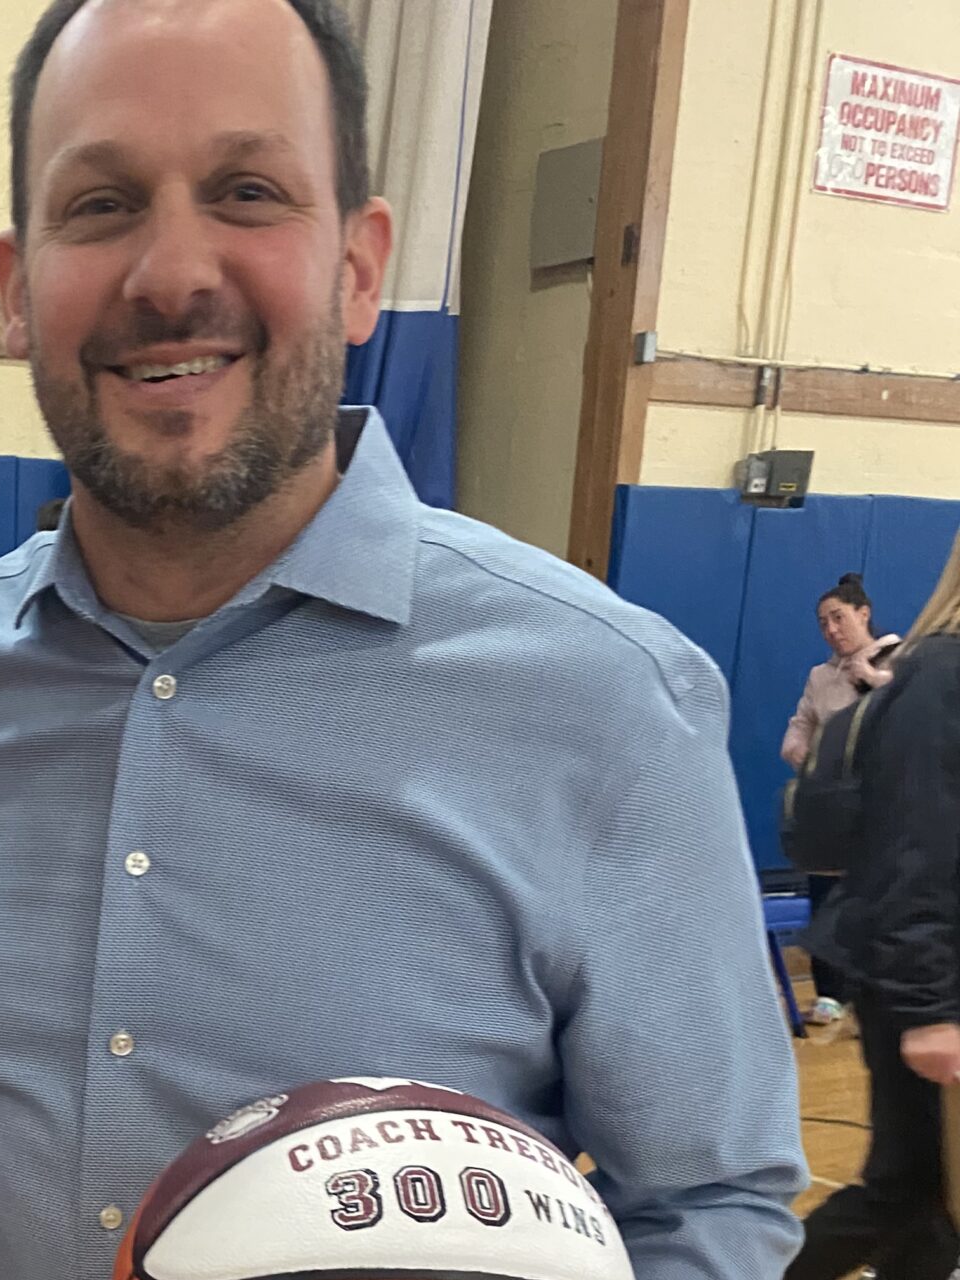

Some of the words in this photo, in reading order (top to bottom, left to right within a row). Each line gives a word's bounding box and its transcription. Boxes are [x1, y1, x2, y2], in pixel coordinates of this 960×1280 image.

[850, 71, 942, 112] MAXIMUM
[840, 102, 944, 144] OCCUPANCY
[841, 134, 866, 153] NOT
[871, 139, 888, 157] TO
[890, 143, 935, 166] EXCEED
[864, 162, 941, 197] PERSONS
[288, 1118, 442, 1172] COACH
[325, 1165, 512, 1231] 300
[524, 1189, 606, 1246] WINS
